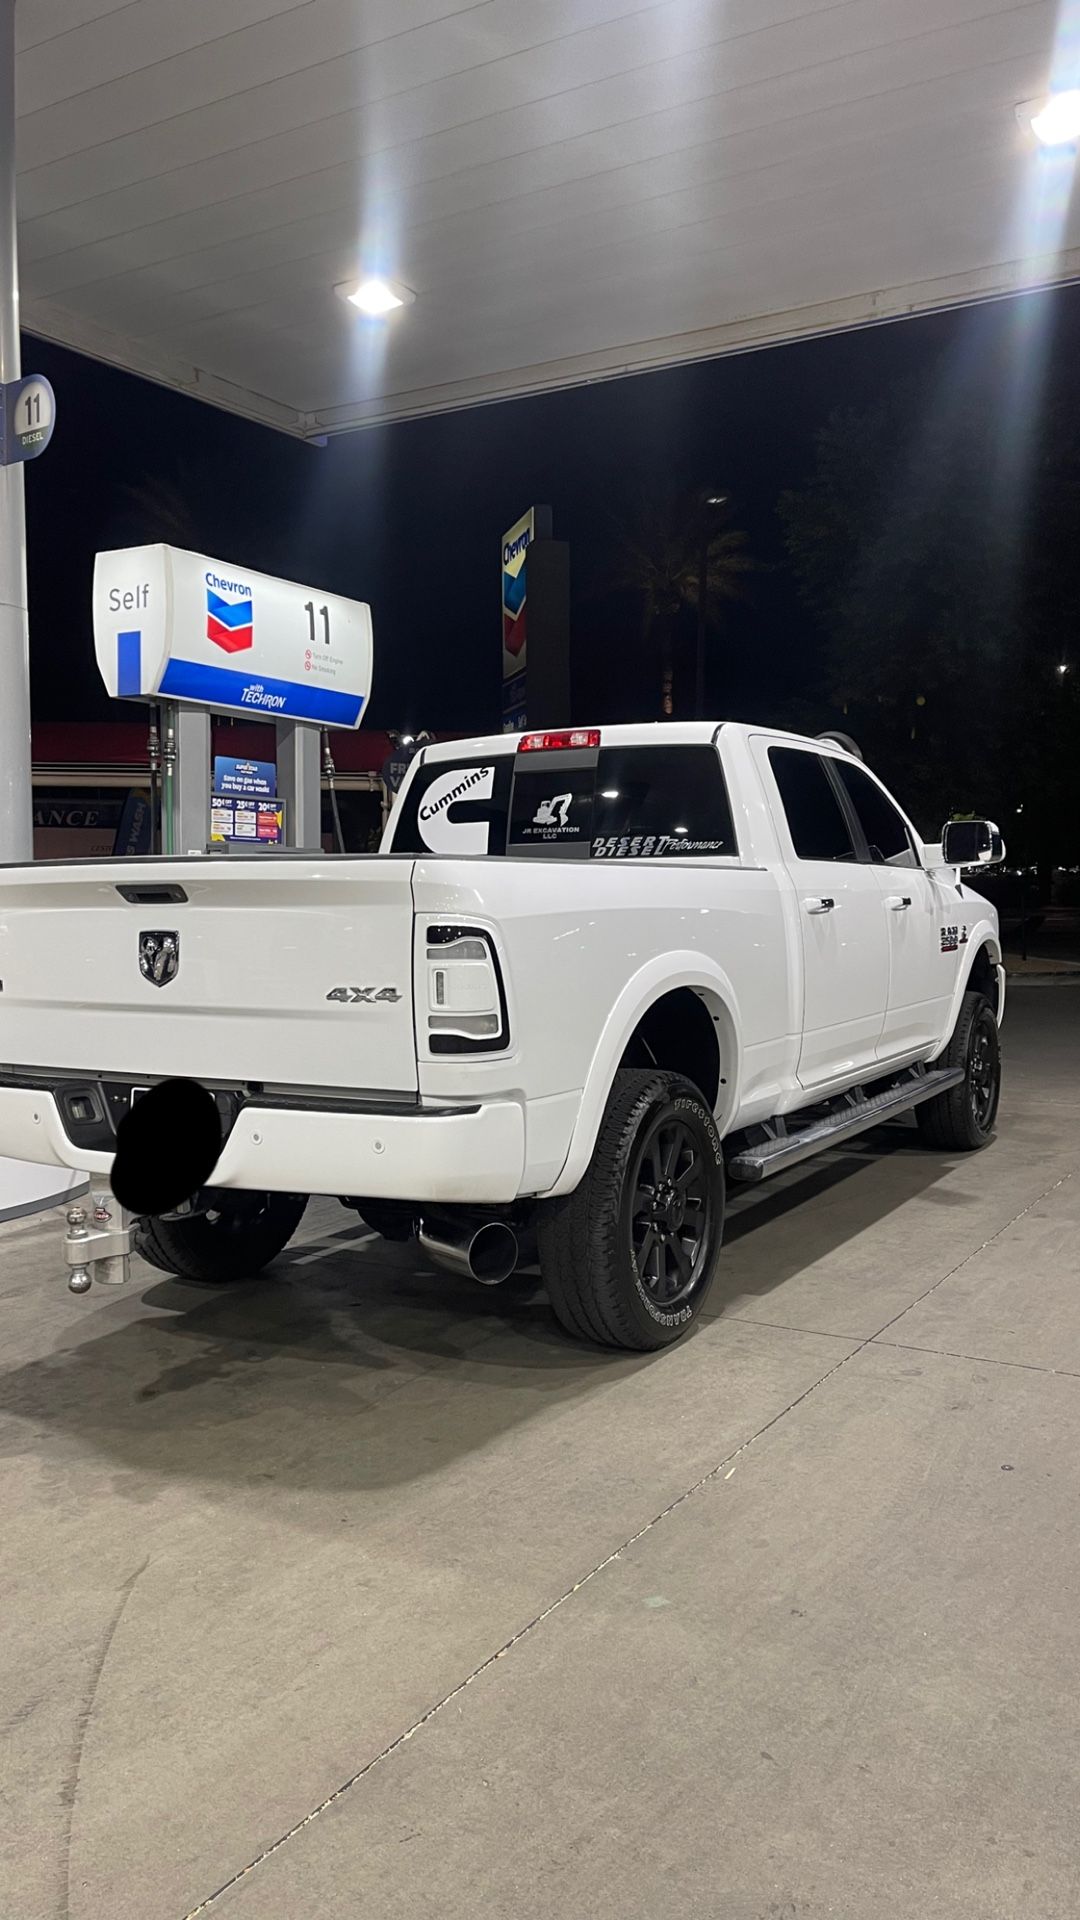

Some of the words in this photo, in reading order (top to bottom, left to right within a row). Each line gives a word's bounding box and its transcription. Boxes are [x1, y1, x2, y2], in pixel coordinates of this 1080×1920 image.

[25, 393, 40, 426] 11
[22, 432, 44, 446] DIESEL
[504, 527, 530, 566] Chevron
[205, 572, 252, 597] Chevron
[109, 583, 149, 612] Self
[304, 601, 330, 645] 11
[250, 683, 264, 693] with
[241, 687, 287, 709] TECHRON
[390, 762, 408, 774] FR
[232, 782, 242, 792] buy
[244, 777, 252, 785] gas
[253, 778, 267, 786] when
[420, 767, 489, 821] Cummins
[533, 826, 580, 834] EXCAVATION
[592, 836, 671, 848] DESERT
[594, 846, 667, 856] DIESEL
